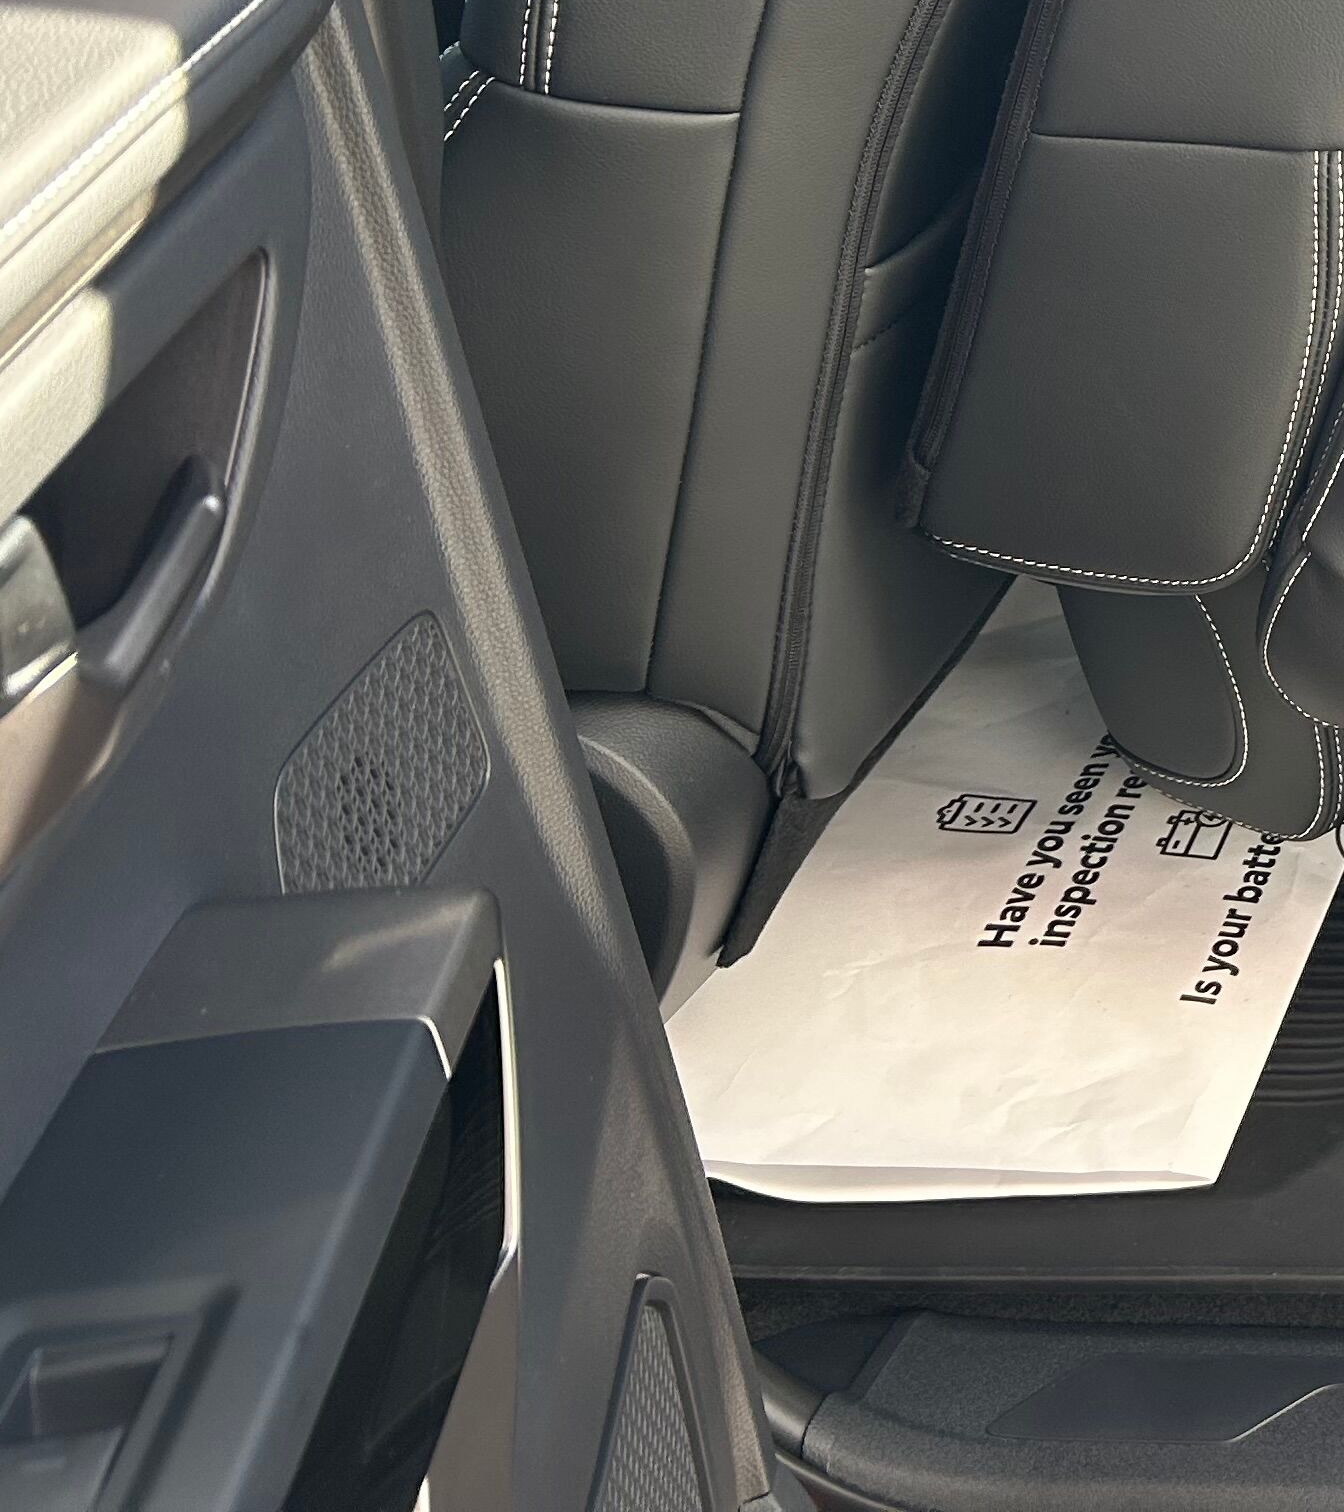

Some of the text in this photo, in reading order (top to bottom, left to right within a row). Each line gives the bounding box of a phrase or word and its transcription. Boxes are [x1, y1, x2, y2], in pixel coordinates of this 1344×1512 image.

[976, 872, 1045, 948] Have
[1025, 820, 1076, 869] you
[1057, 762, 1110, 816] seen
[1028, 804, 1136, 947] inspection
[1179, 979, 1223, 1005] Is
[1201, 907, 1252, 977] your
